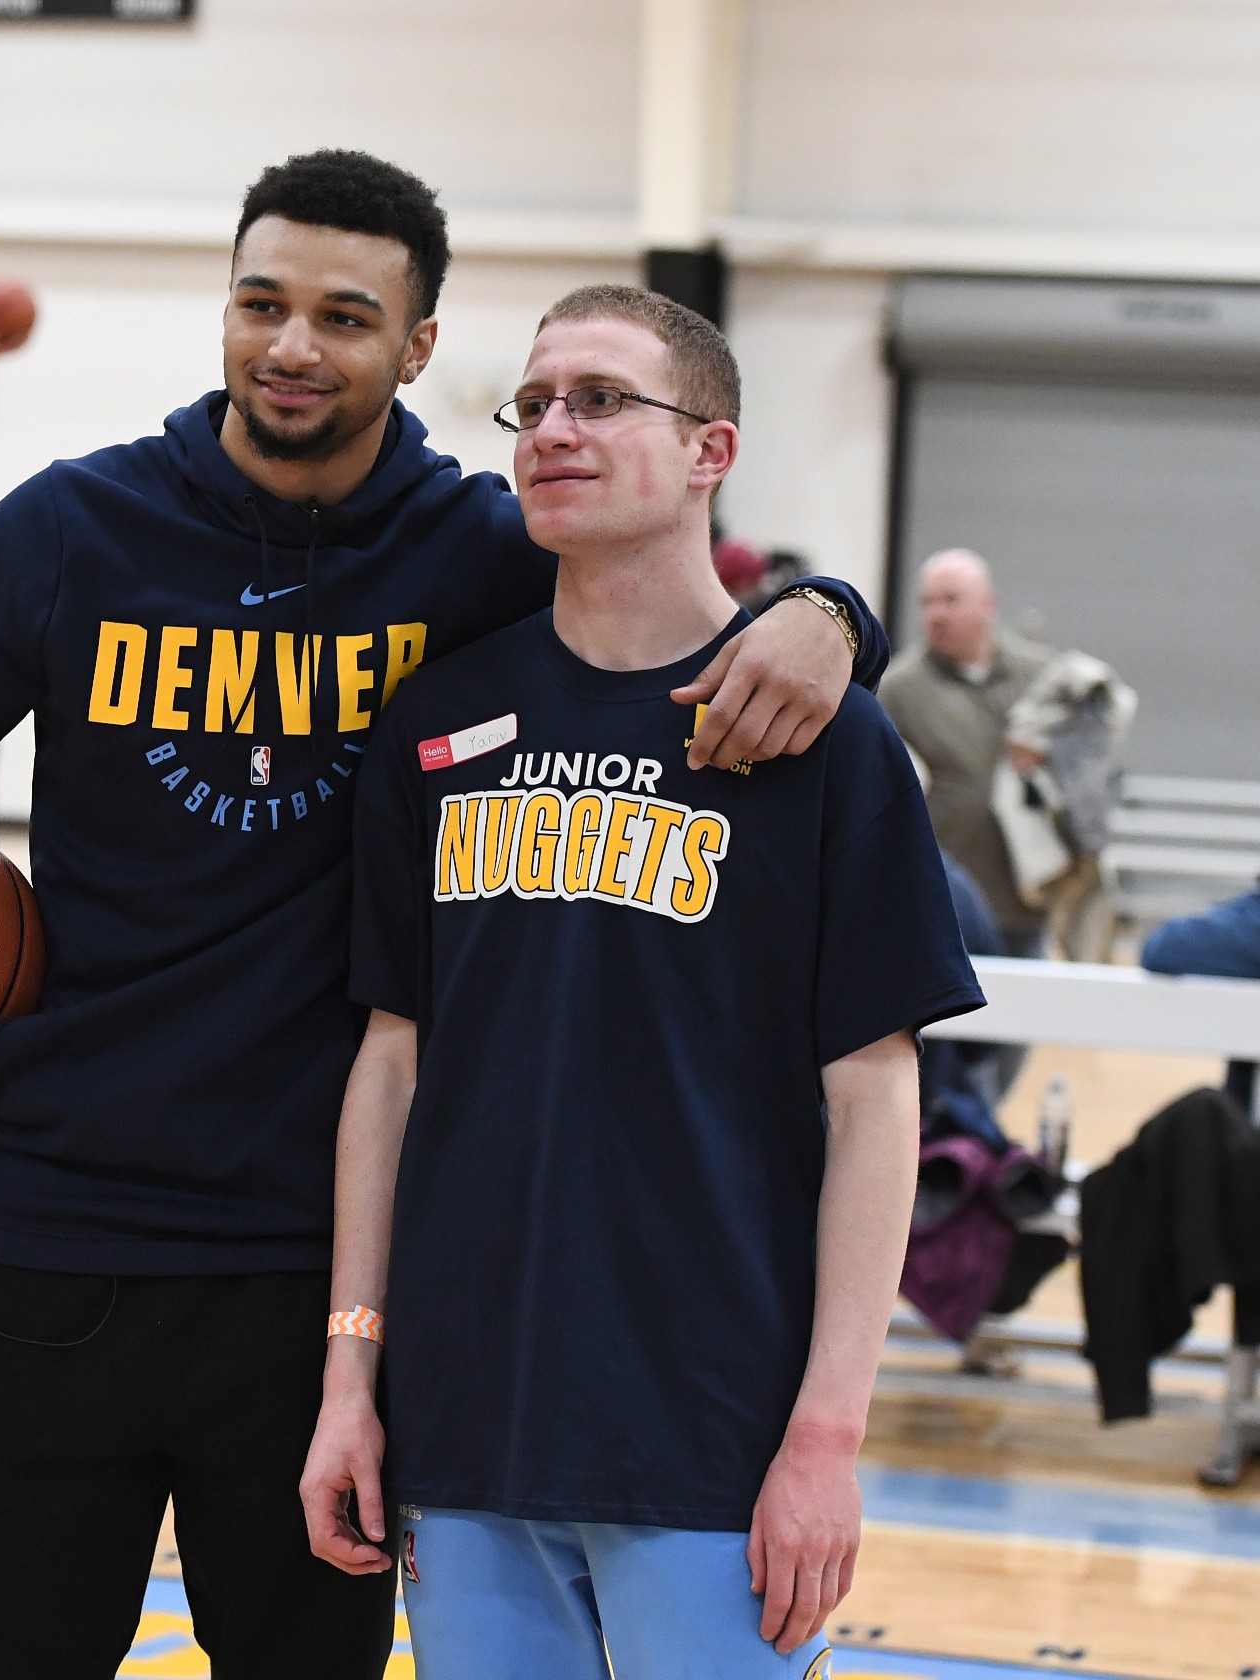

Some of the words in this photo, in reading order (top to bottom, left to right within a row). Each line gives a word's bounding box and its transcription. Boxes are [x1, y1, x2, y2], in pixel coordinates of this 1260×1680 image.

[88, 621, 427, 735] DENVER
[423, 745, 448, 758] Hello
[468, 731, 507, 752] Yariv
[499, 752, 663, 793] JUNIOR
[435, 790, 730, 922] NUGGETS
